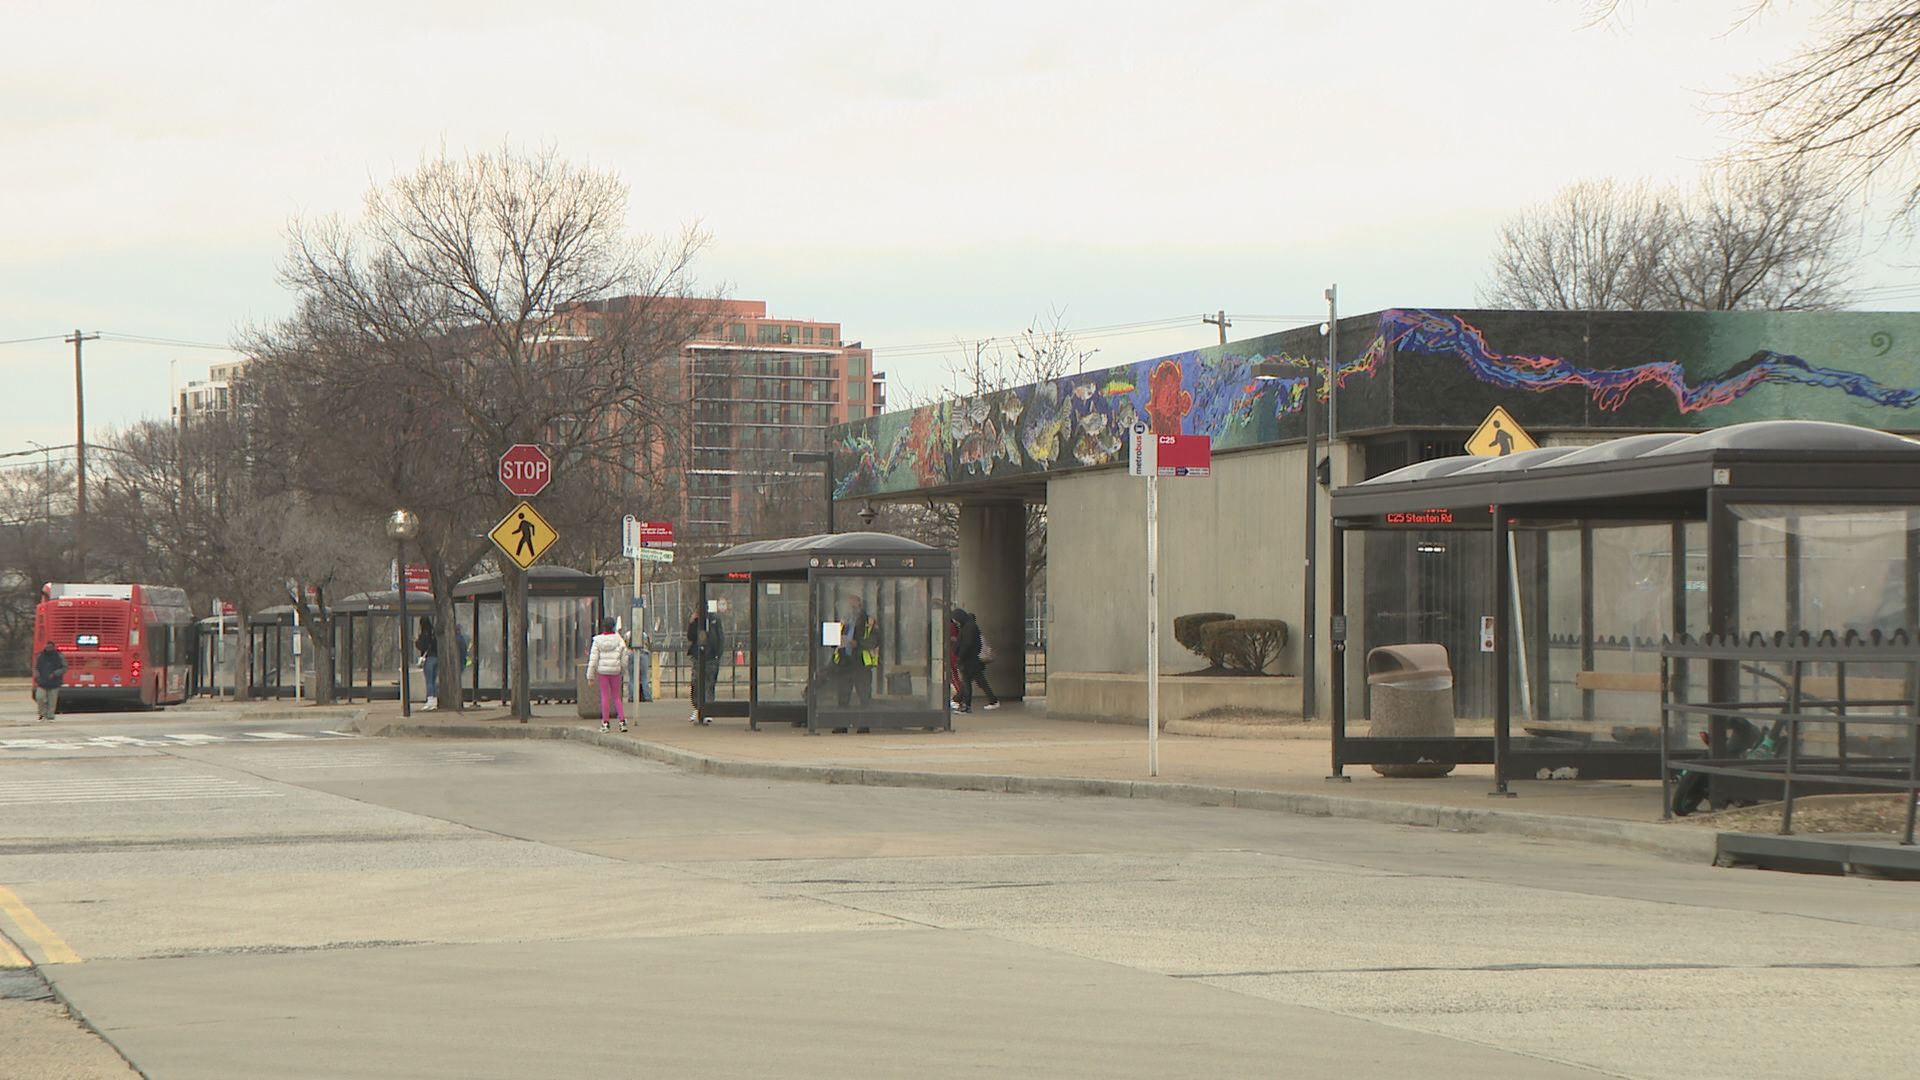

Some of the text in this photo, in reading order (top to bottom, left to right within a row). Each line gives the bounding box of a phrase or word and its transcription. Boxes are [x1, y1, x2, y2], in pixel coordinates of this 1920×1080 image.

[1160, 436, 1176, 444] C25
[503, 461, 547, 480] STOP
[1388, 513, 1452, 522] C25 Stanton Rd
